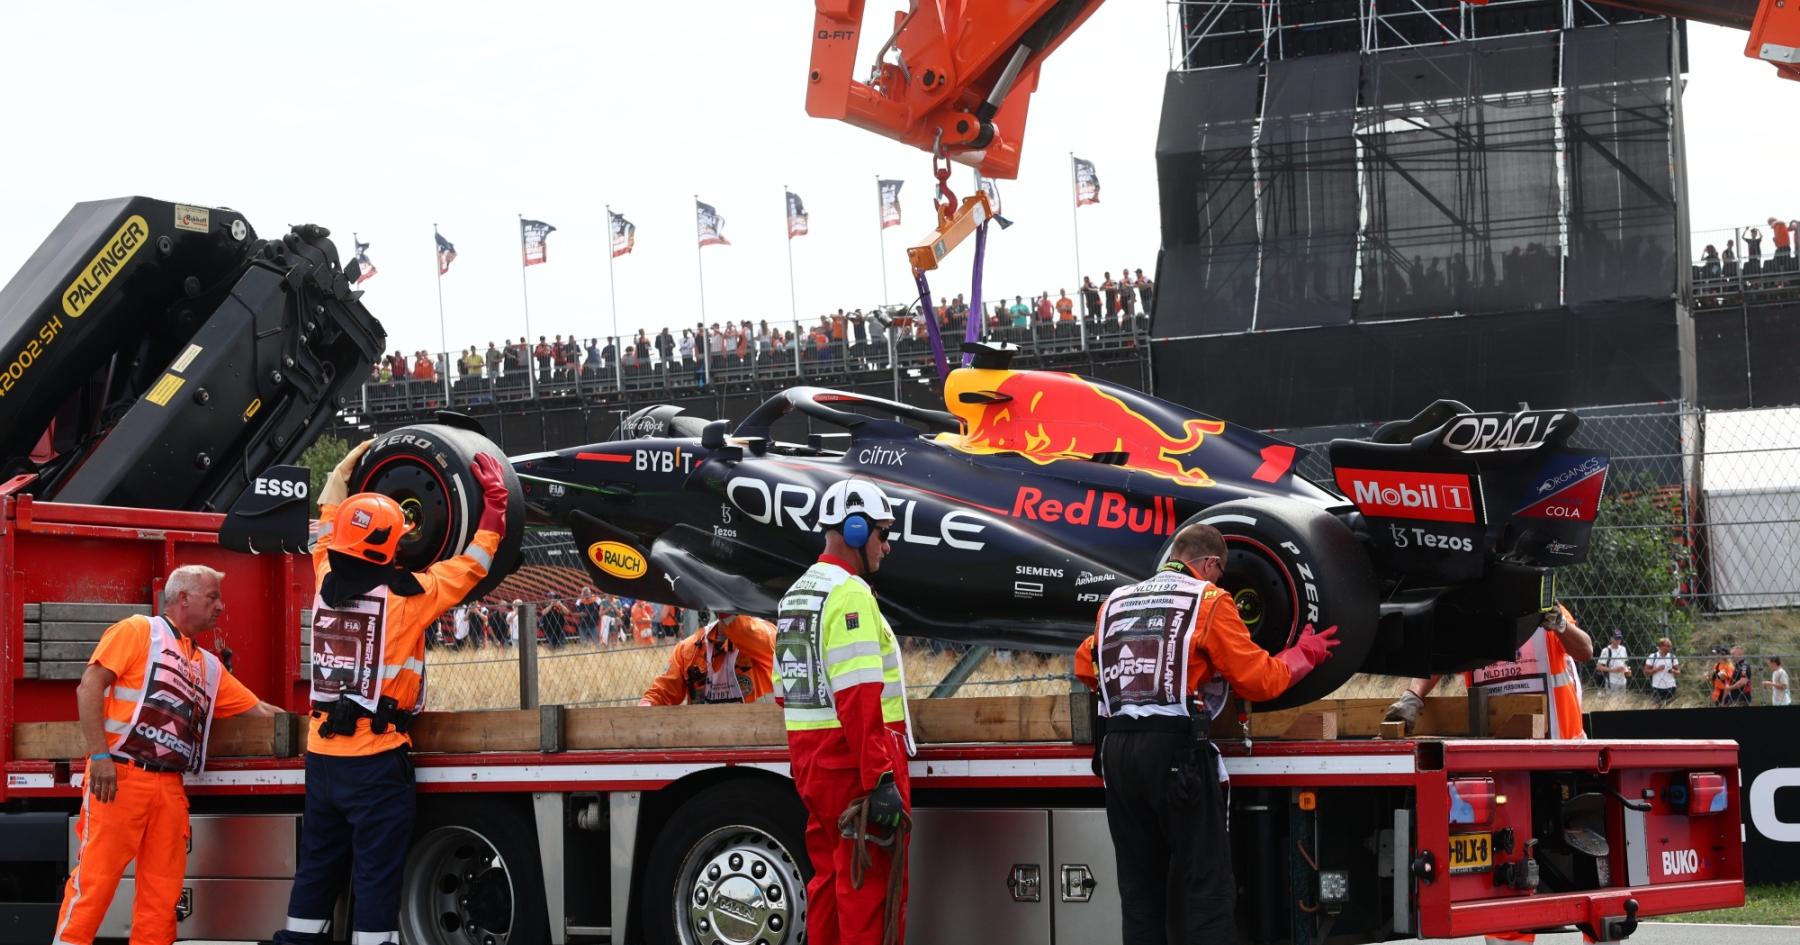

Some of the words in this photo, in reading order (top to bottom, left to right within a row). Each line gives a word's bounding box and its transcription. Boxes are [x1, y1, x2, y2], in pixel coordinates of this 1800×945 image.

[817, 30, 854, 40] Q-FIT
[67, 221, 145, 312] PALFINGER
[644, 420, 664, 432] Rock
[1442, 413, 1566, 451] ORACLE
[375, 434, 432, 452] ZERO
[635, 447, 693, 474] BYBIT
[859, 446, 907, 466] citrix
[1545, 456, 1599, 491] ORGANICS
[254, 477, 308, 498] ESSO
[1353, 480, 1438, 508] Mobil
[1450, 487, 1462, 508] 1
[727, 476, 986, 551] ORLE
[1012, 486, 1096, 526] Red
[1098, 491, 1176, 536] Bull
[1545, 506, 1580, 518] COLA
[713, 525, 737, 538] Tezos
[1412, 528, 1473, 552] Tezos
[603, 549, 641, 573] RAUCH
[1015, 565, 1064, 578] SIEMENS
[1280, 540, 1300, 555] P
[1296, 562, 1319, 635] ZER
[344, 621, 360, 631] FIA
[1148, 616, 1166, 627] FIA
[361, 616, 376, 697] NETHERLANDS
[1163, 610, 1185, 703] NETHERLANDS
[1103, 658, 1156, 683] COURSE
[135, 722, 192, 758] COURSE
[1661, 848, 1698, 876] BUKO
[719, 899, 755, 921] MAN
